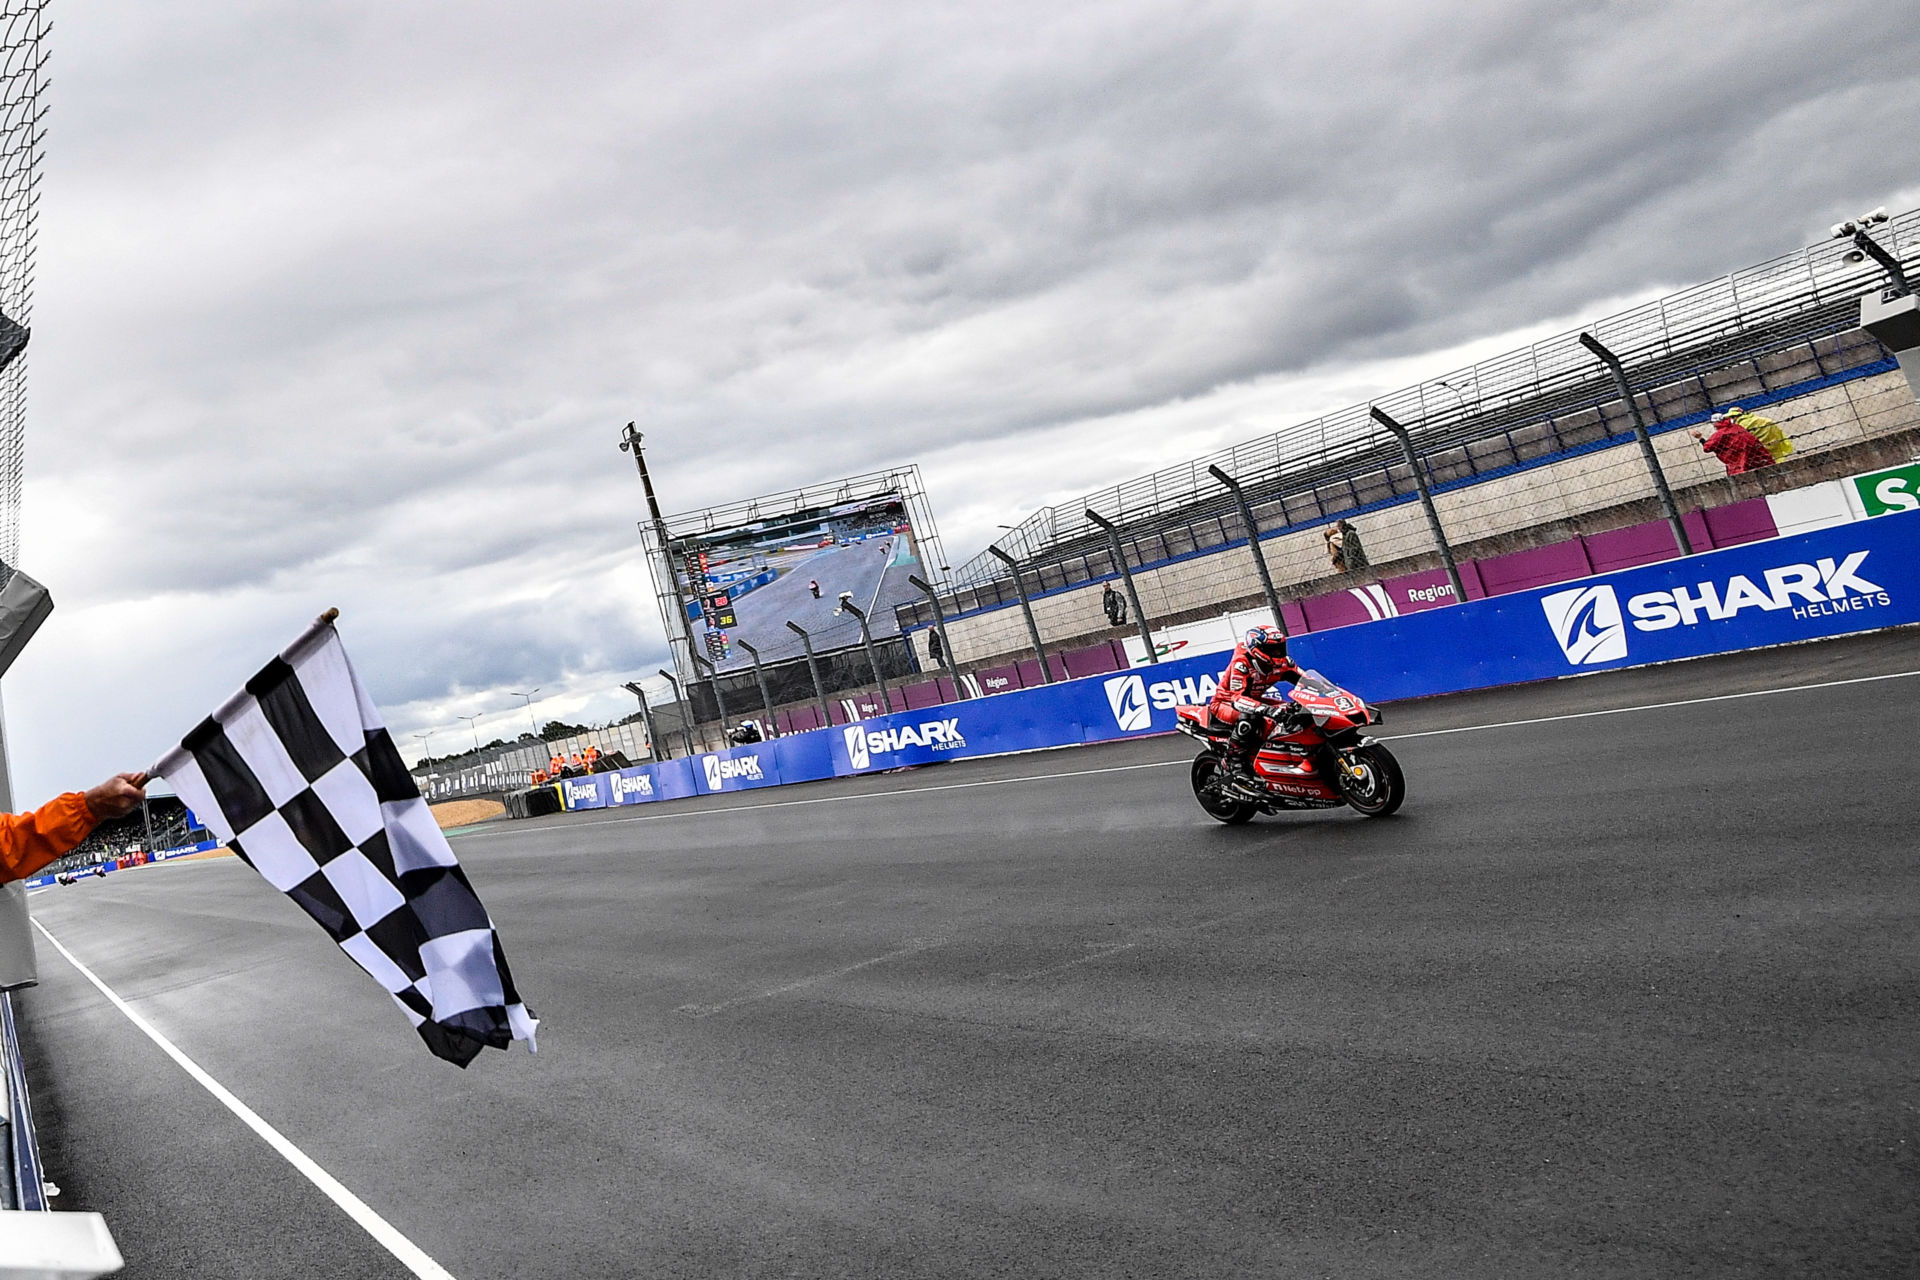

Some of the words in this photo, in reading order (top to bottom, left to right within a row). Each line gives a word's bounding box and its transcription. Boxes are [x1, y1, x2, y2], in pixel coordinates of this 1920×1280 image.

[1875, 477, 1920, 514] S
[1627, 549, 1885, 632] SHARK
[1792, 591, 1892, 620] HELMETS
[720, 616, 733, 625] 36
[1149, 672, 1230, 710] SHA
[867, 717, 965, 754] SHARK
[931, 740, 966, 752] HELMETS
[720, 755, 763, 780] SHARK
[572, 783, 597, 800] SHARK
[621, 774, 653, 794] SHARK
